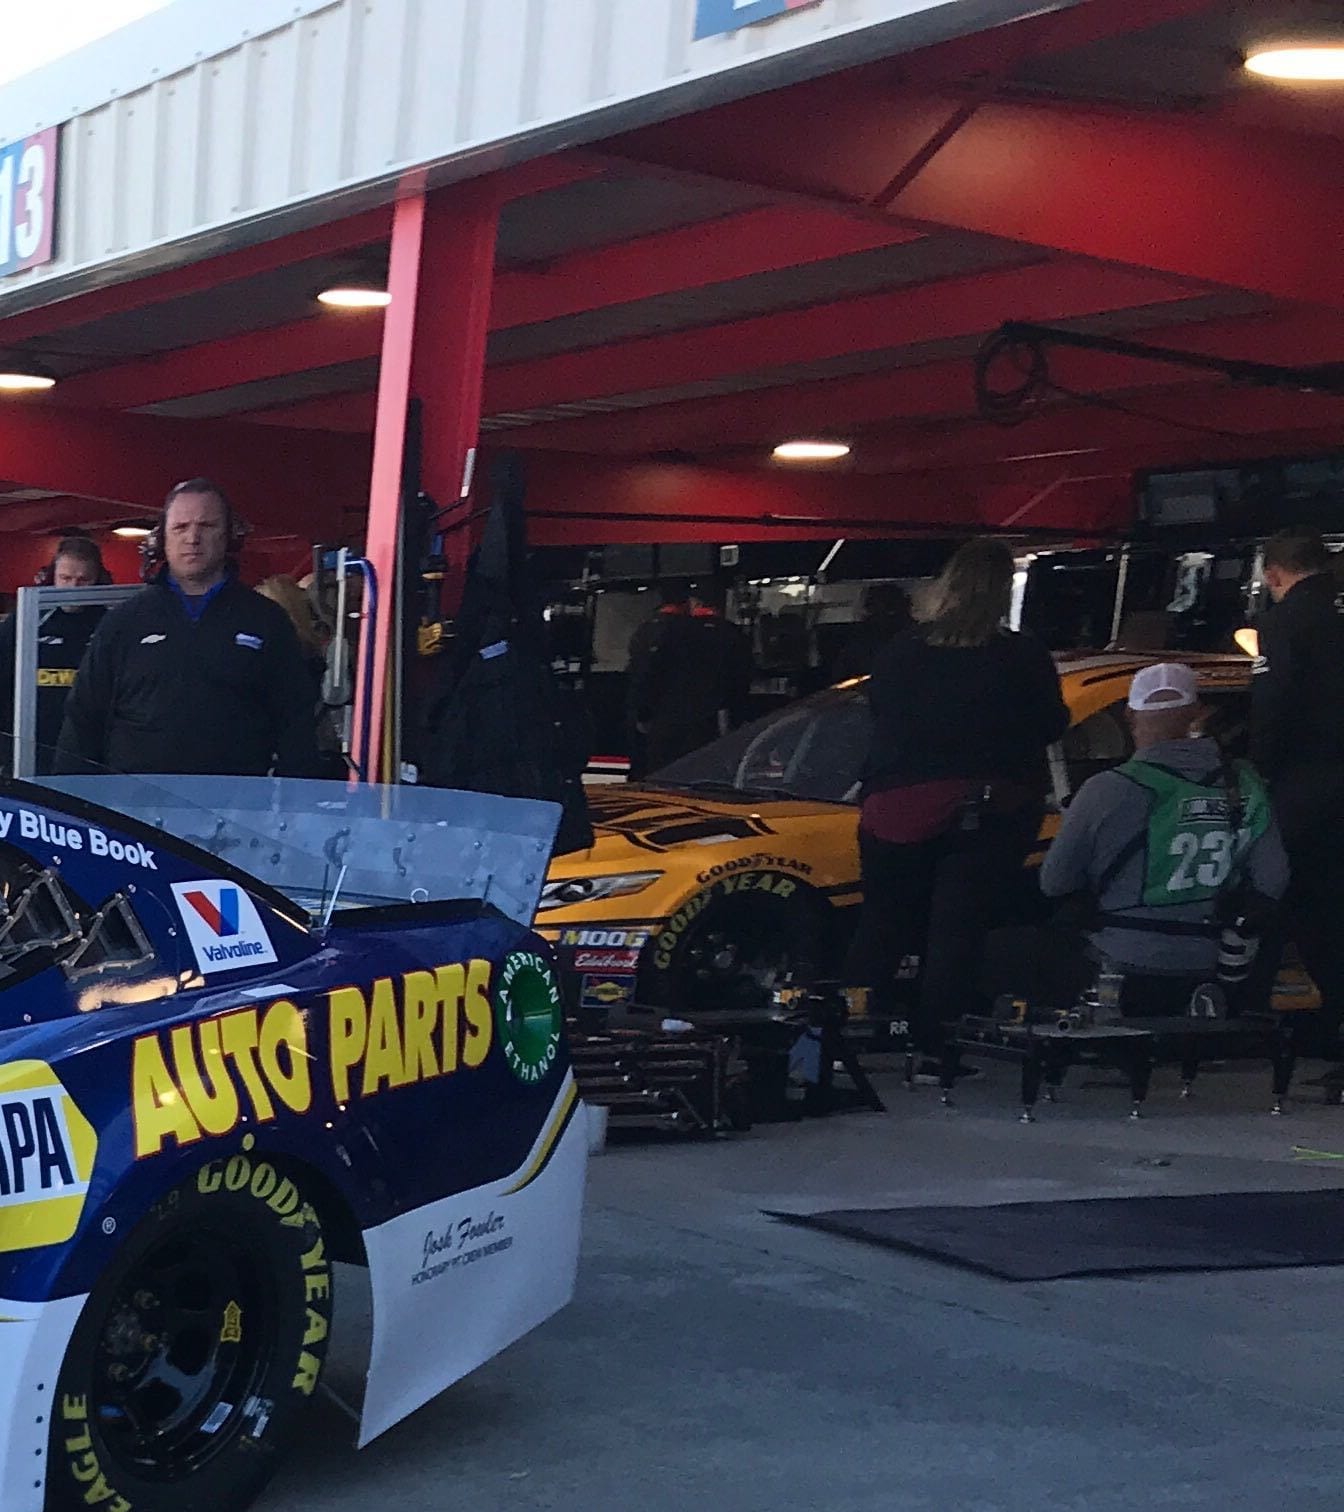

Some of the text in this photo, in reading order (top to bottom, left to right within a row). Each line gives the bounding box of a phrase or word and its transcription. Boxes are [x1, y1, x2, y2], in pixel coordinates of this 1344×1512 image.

[20, 809, 82, 850] Blue
[90, 829, 158, 870] Book
[201, 939, 265, 962] Valvoline
[563, 930, 649, 947] MOOG
[498, 951, 559, 1005] AMERICAN
[131, 958, 493, 1160] AUTO PARTS
[505, 1031, 561, 1082] ETHANOL
